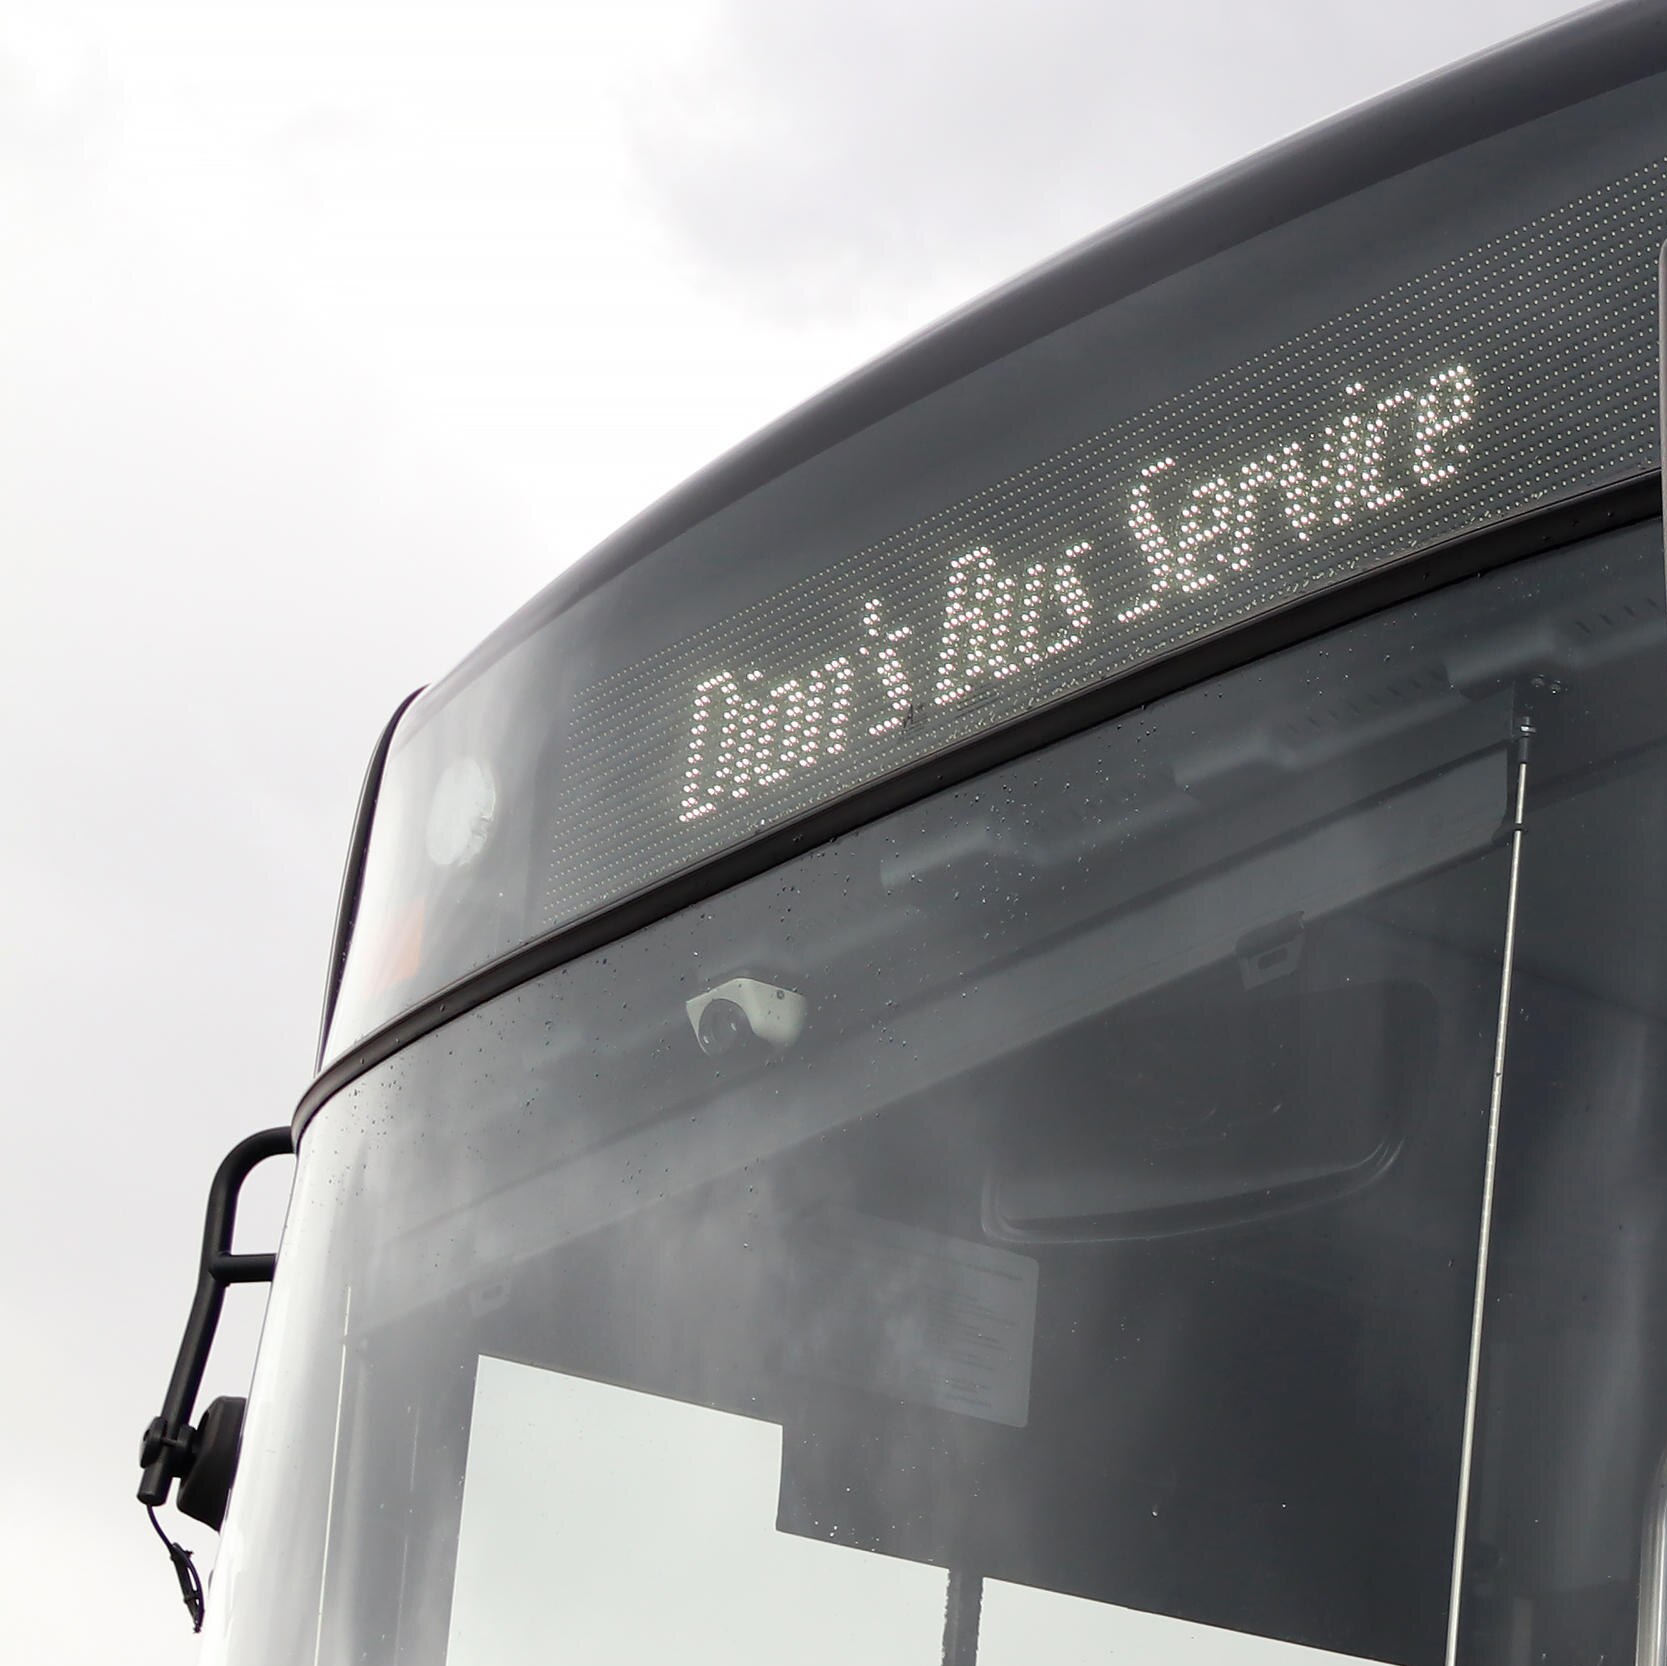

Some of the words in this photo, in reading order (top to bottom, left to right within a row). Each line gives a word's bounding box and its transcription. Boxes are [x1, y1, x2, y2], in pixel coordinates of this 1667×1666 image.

[679, 599, 912, 822] Dion's
[934, 541, 1093, 705] Bus
[1117, 364, 1474, 623] Service
